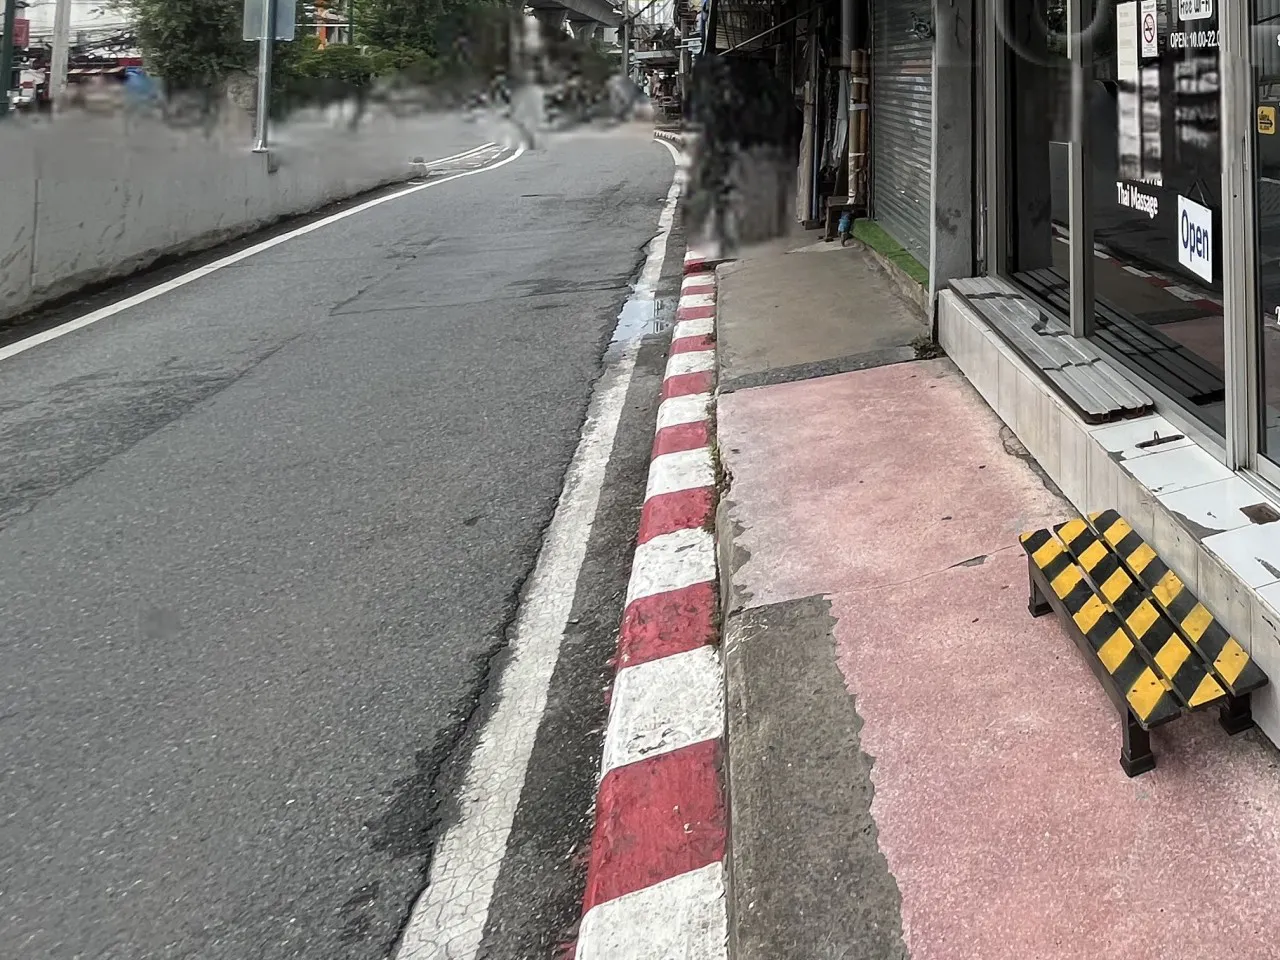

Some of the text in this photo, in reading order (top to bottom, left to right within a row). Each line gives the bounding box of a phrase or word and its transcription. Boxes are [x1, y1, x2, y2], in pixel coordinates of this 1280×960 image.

[1170, 32, 1189, 48] OPEN:
[1116, 181, 1158, 219] Thai Massage
[1181, 209, 1209, 262] Open
